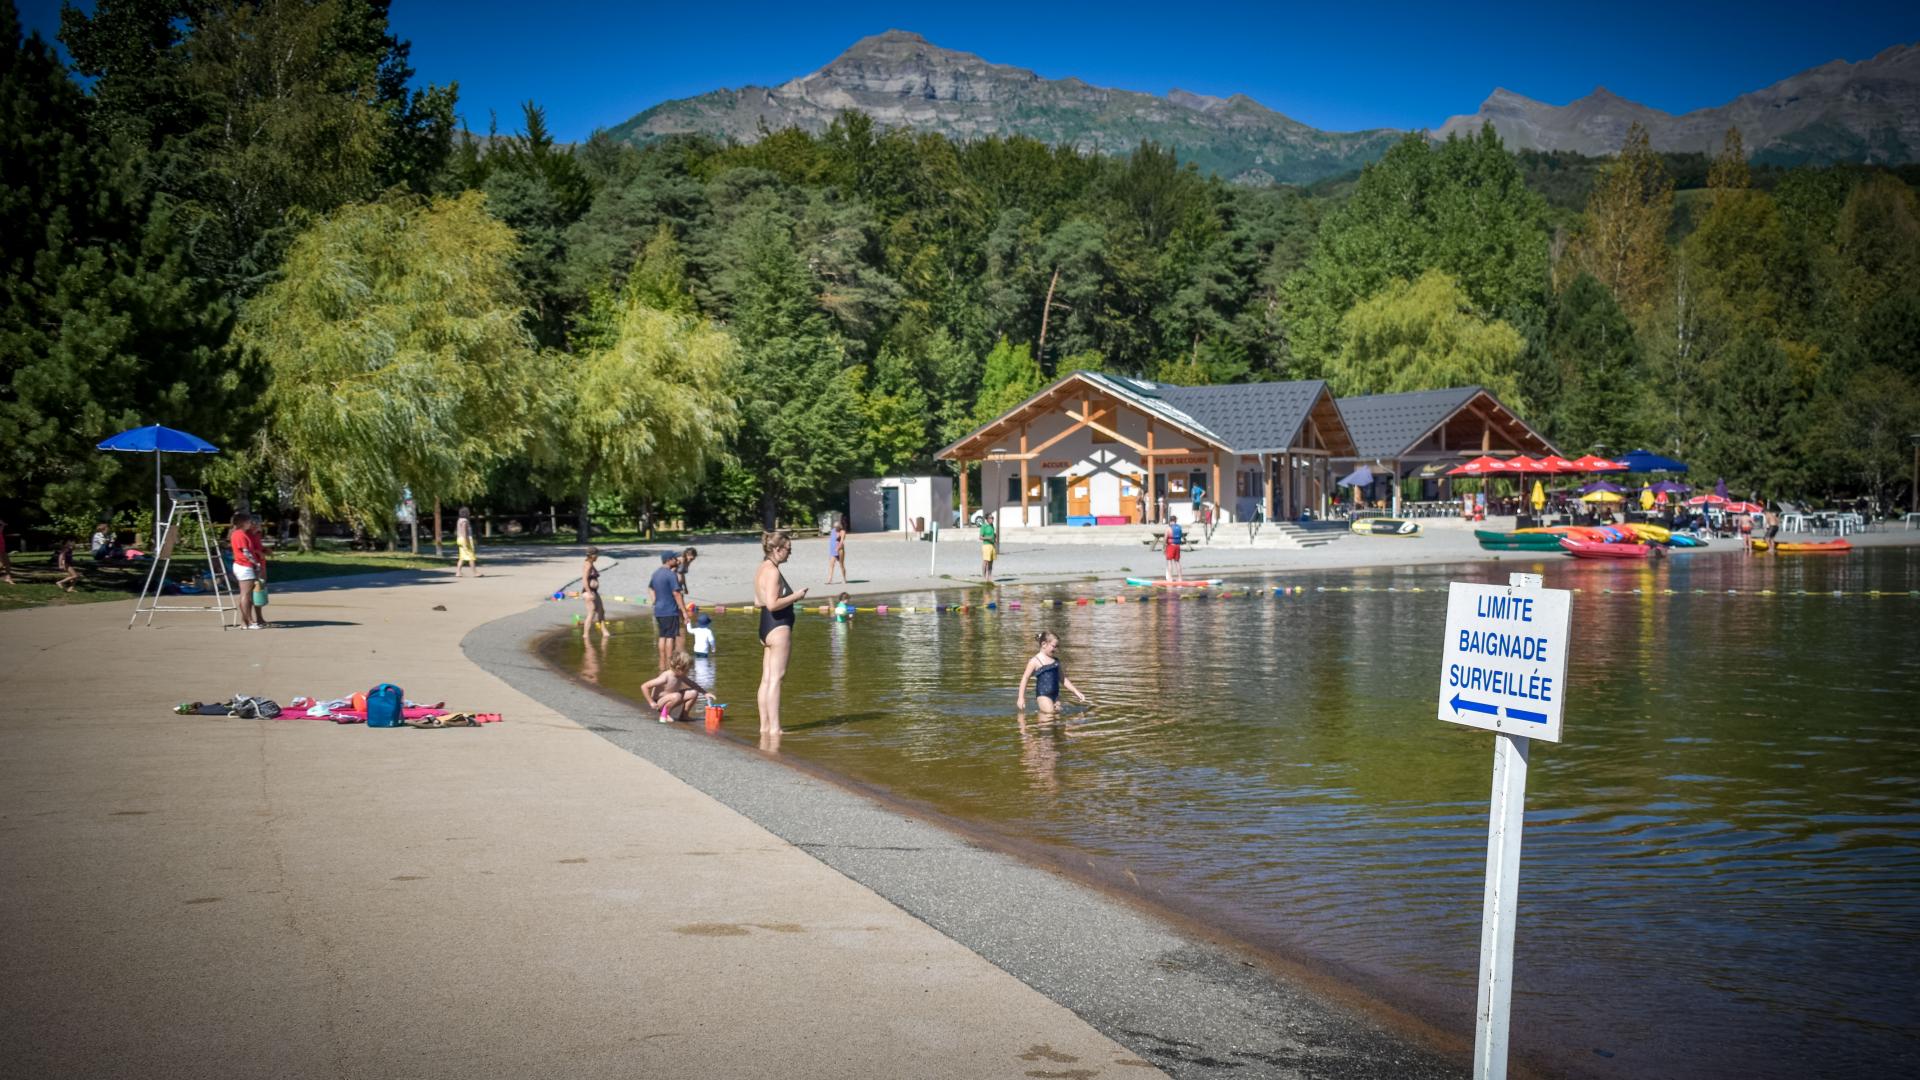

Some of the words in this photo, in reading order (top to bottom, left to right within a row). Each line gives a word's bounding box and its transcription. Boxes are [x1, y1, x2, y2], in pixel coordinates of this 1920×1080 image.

[1176, 455, 1208, 465] SECOURS
[1477, 595, 1534, 622] LIMITE
[1459, 629, 1548, 662] BAIGNADE
[1450, 664, 1553, 702] SURVEILLÉE
